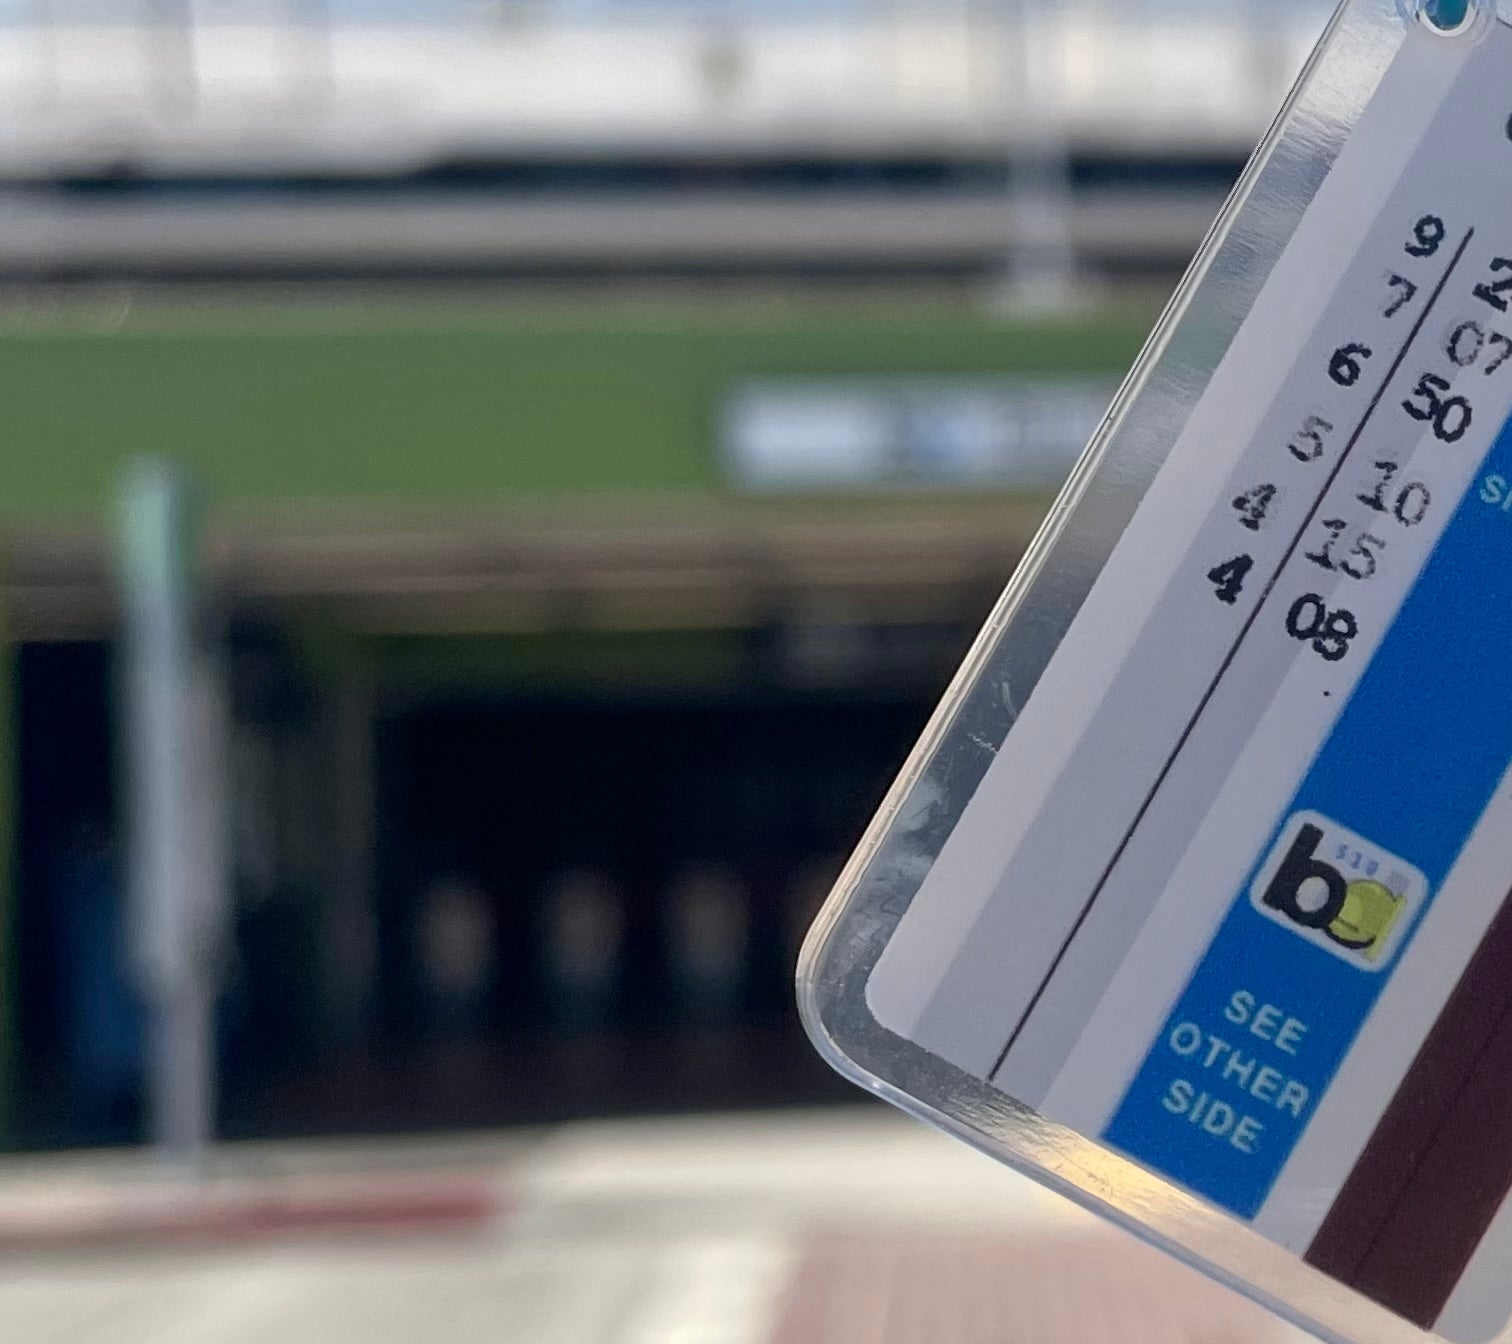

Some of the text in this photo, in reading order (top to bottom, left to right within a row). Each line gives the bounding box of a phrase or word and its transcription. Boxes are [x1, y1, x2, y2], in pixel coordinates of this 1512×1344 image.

[1405, 214, 1445, 257] 9
[1381, 274, 1417, 318] 7
[1328, 342, 1472, 443] 6 50
[1232, 483, 1276, 531] 4
[1288, 416, 1431, 527] 5 10
[1207, 553, 1358, 661] 4 08
[1224, 990, 1308, 1056] SEE
[1169, 1022, 1309, 1118] OTHER
[1161, 1080, 1264, 1154] SIDE
